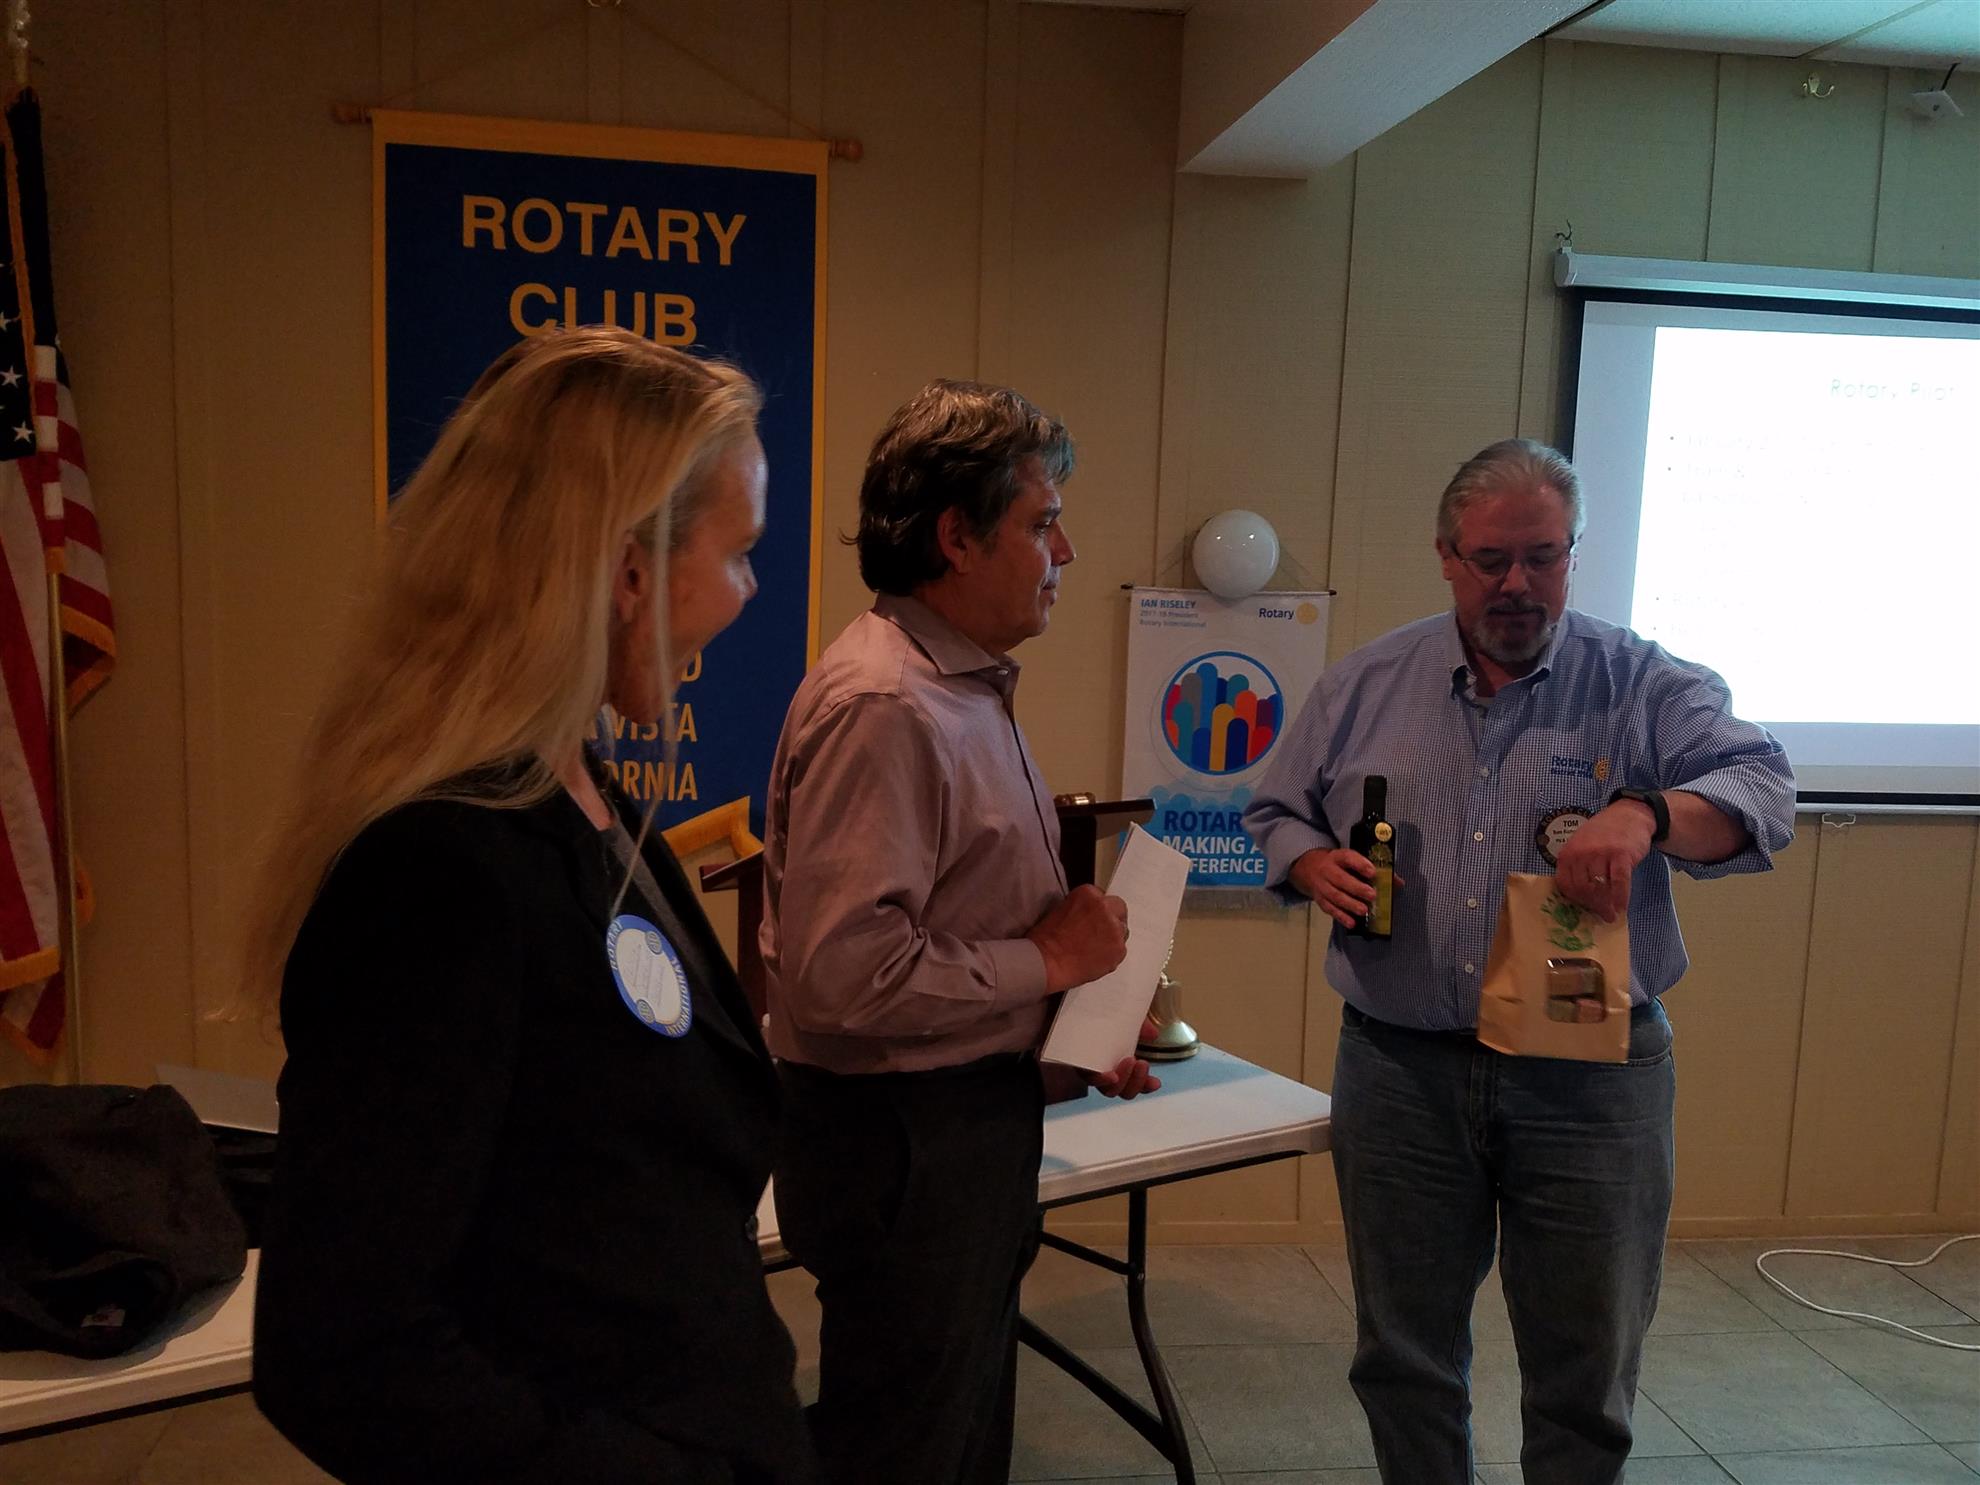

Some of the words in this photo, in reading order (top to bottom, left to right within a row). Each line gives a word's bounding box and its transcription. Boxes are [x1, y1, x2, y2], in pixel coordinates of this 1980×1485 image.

[462, 195, 748, 266] ROTARY
[509, 283, 698, 347] CLUB
[1140, 599, 1158, 609] IAN
[1258, 608, 1294, 621] Rotary
[1164, 810, 1244, 833] ROTAR
[1563, 819, 1579, 828] TOM
[1162, 835, 1246, 855] MAKING
[1190, 858, 1265, 874] FERENCE
